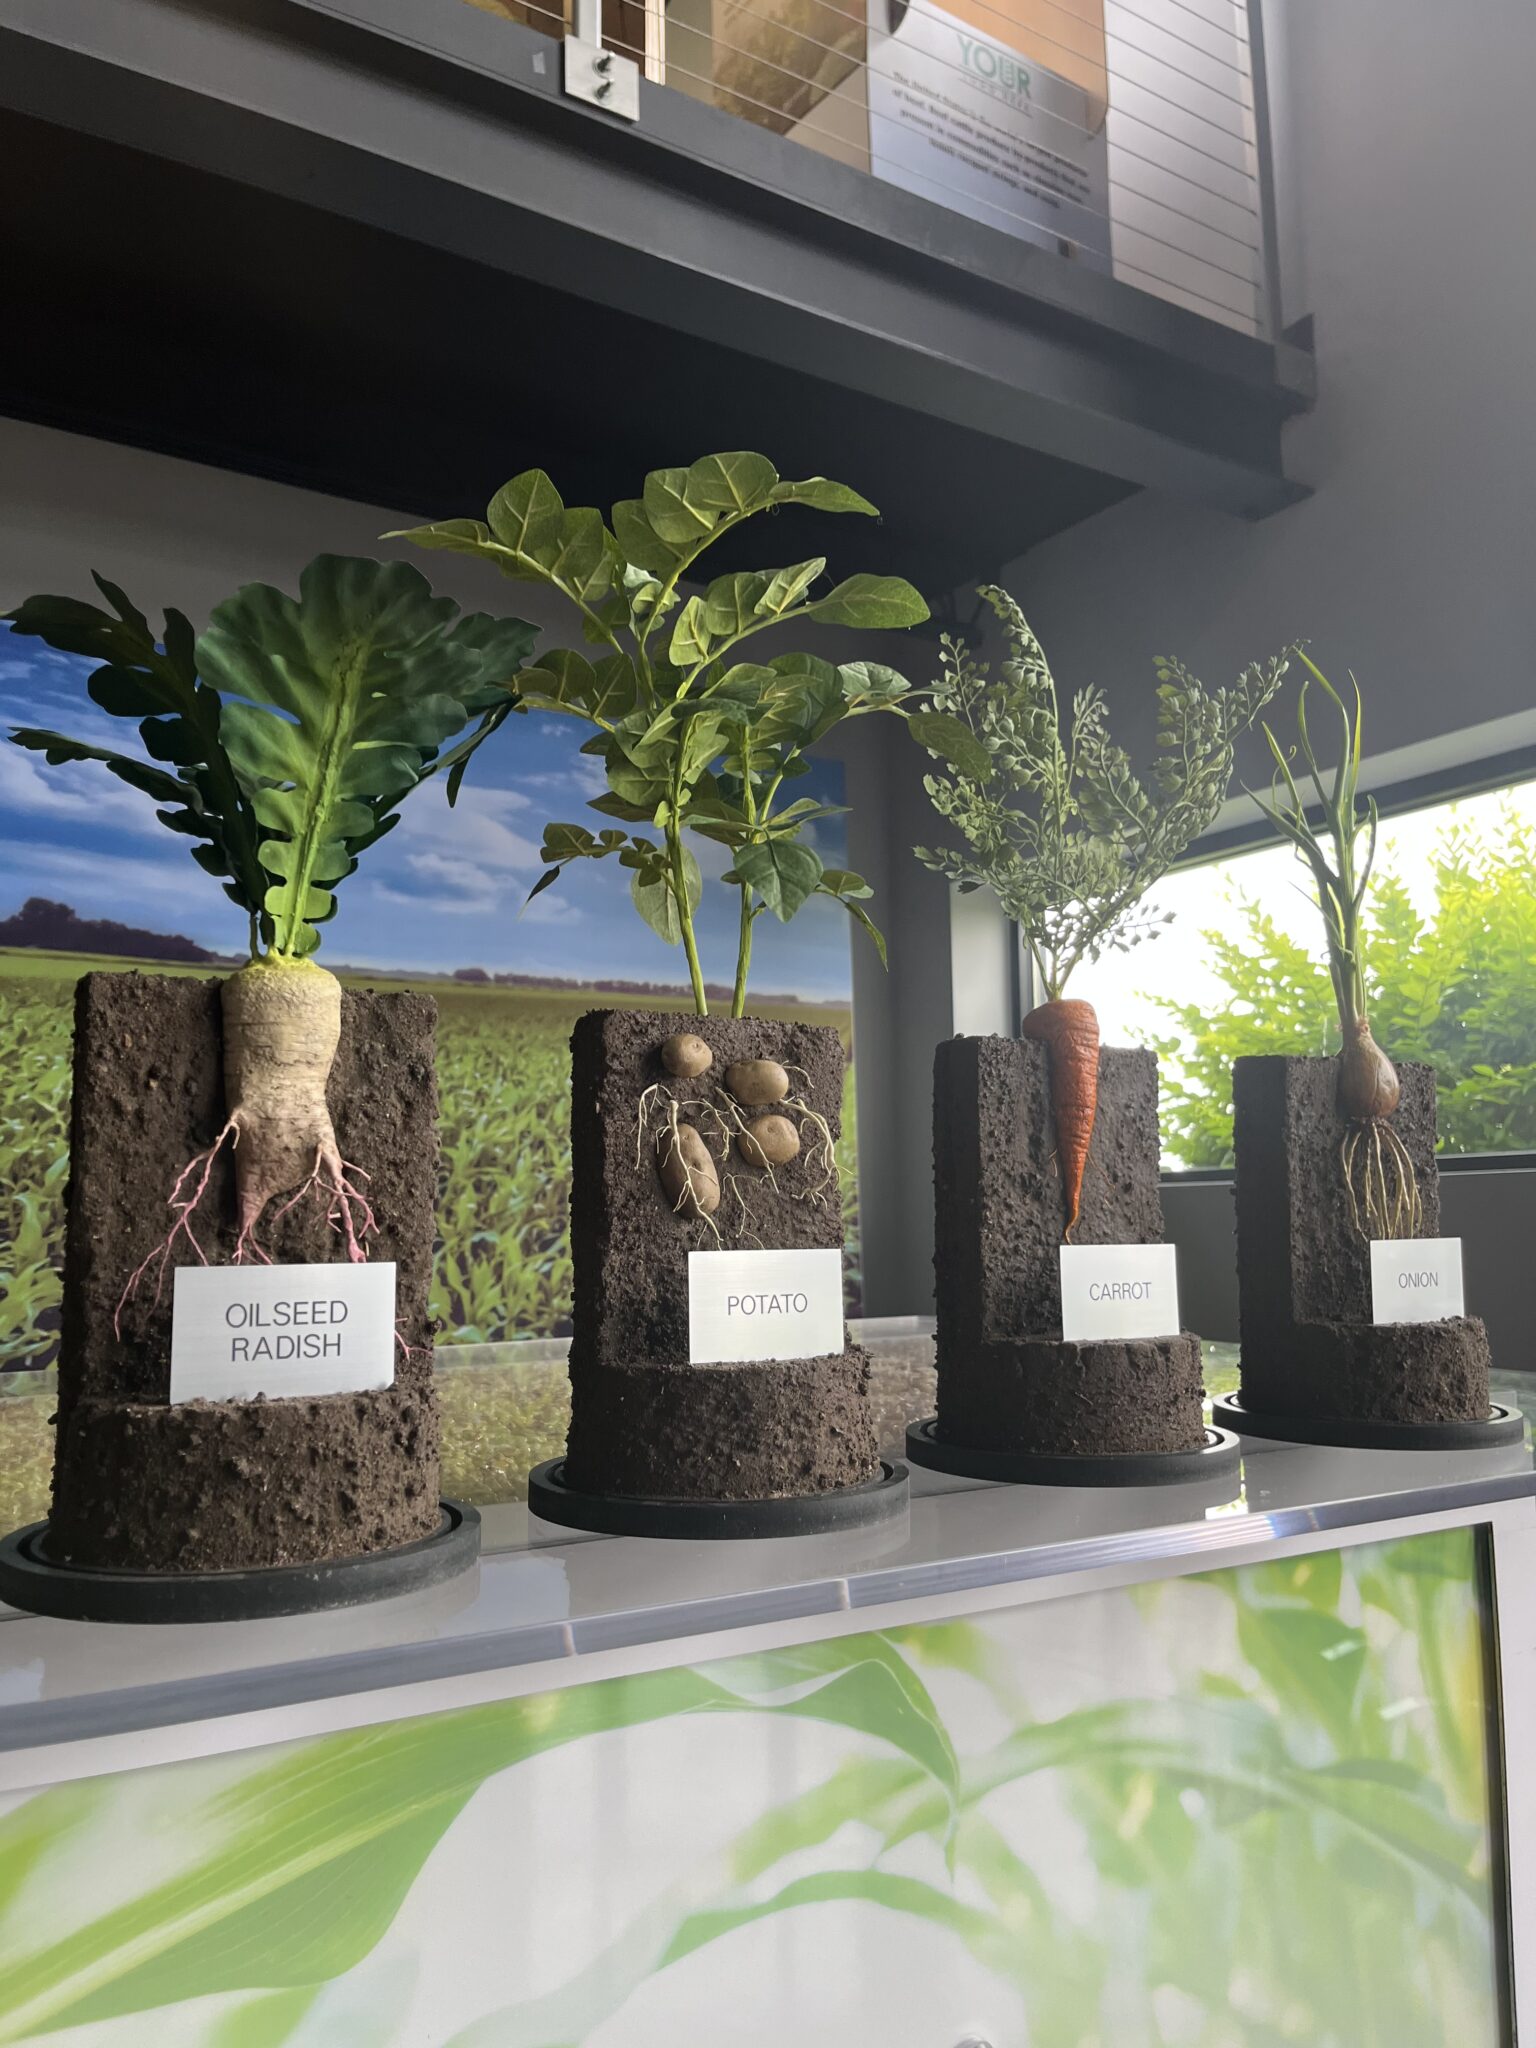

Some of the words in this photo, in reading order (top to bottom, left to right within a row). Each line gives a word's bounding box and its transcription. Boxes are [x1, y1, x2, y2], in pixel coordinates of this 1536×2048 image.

[957, 33, 1032, 99] YOUR
[1089, 1282, 1152, 1301] CARROT
[1398, 1271, 1439, 1289] ONION
[225, 1300, 349, 1328] OILSEED
[727, 1293, 808, 1316] POTATO
[231, 1333, 342, 1362] RADISH
